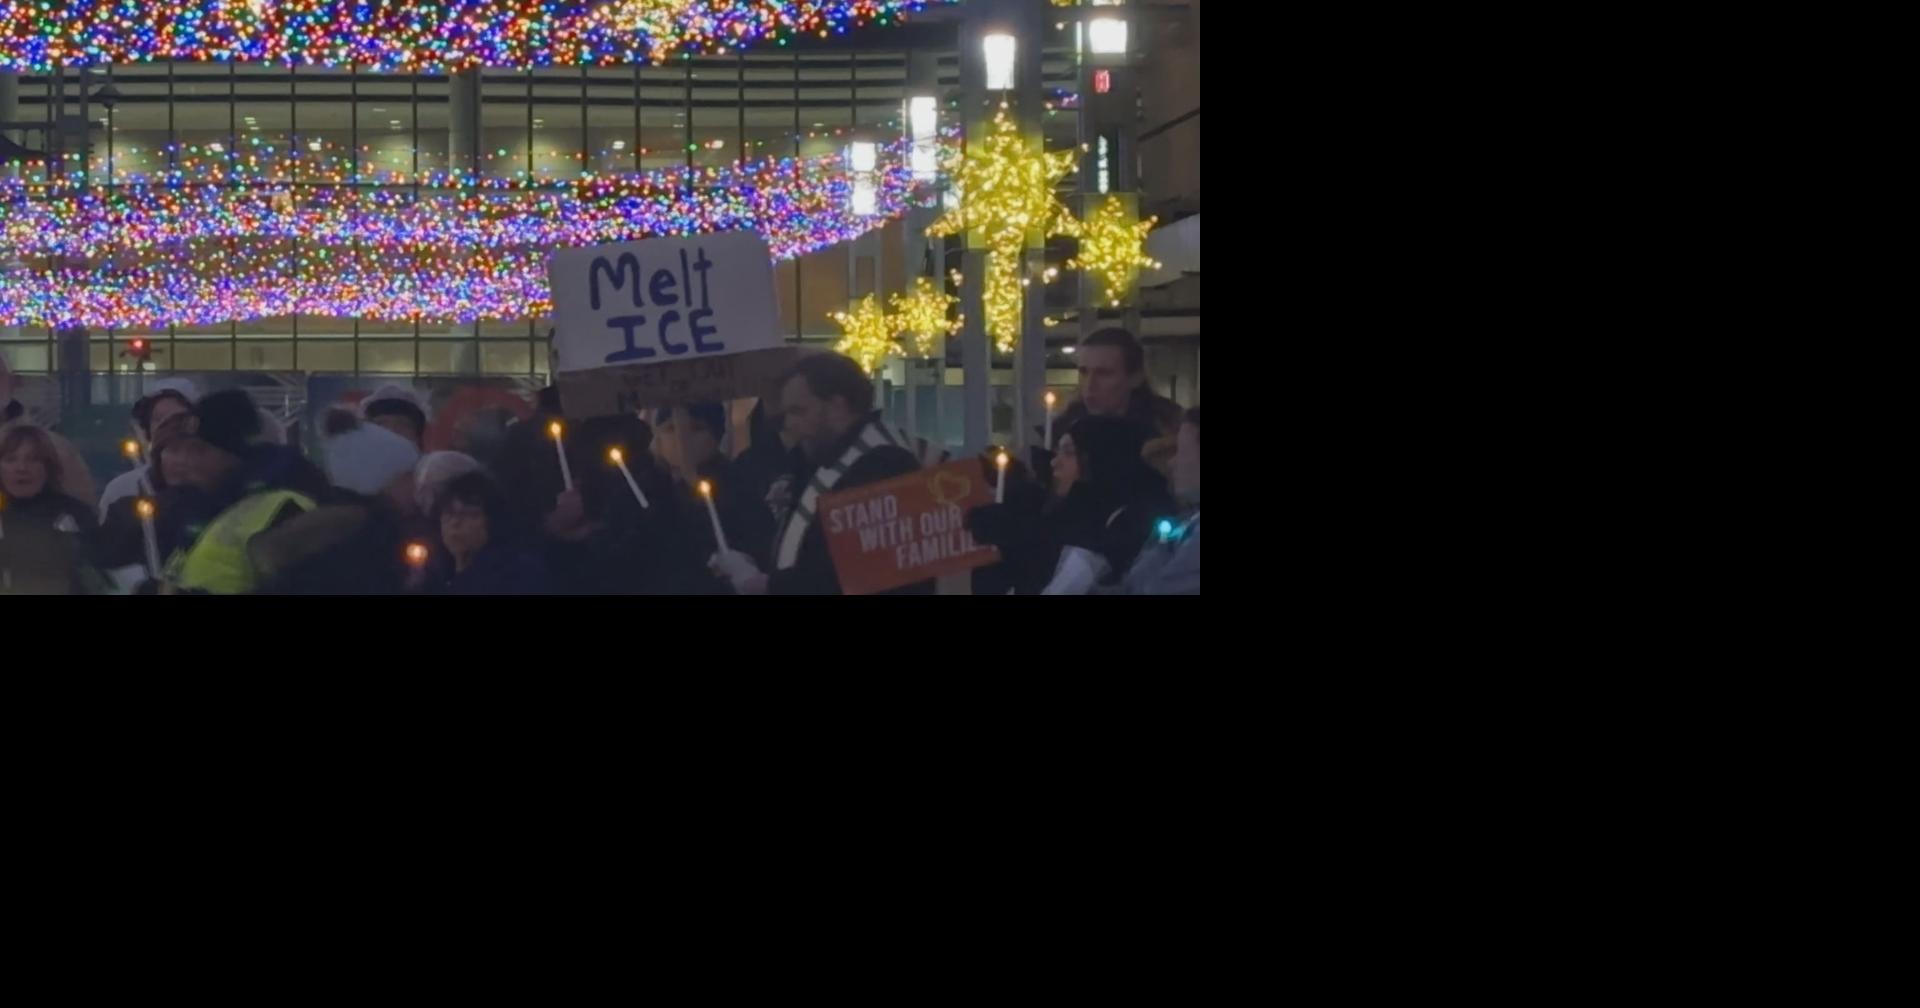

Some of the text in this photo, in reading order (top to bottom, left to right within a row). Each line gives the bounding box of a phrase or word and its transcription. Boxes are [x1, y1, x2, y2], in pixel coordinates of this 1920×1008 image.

[589, 246, 713, 311] Melt
[604, 310, 725, 363] ICE
[829, 494, 898, 534] STAND
[858, 505, 963, 553] WITH OUR
